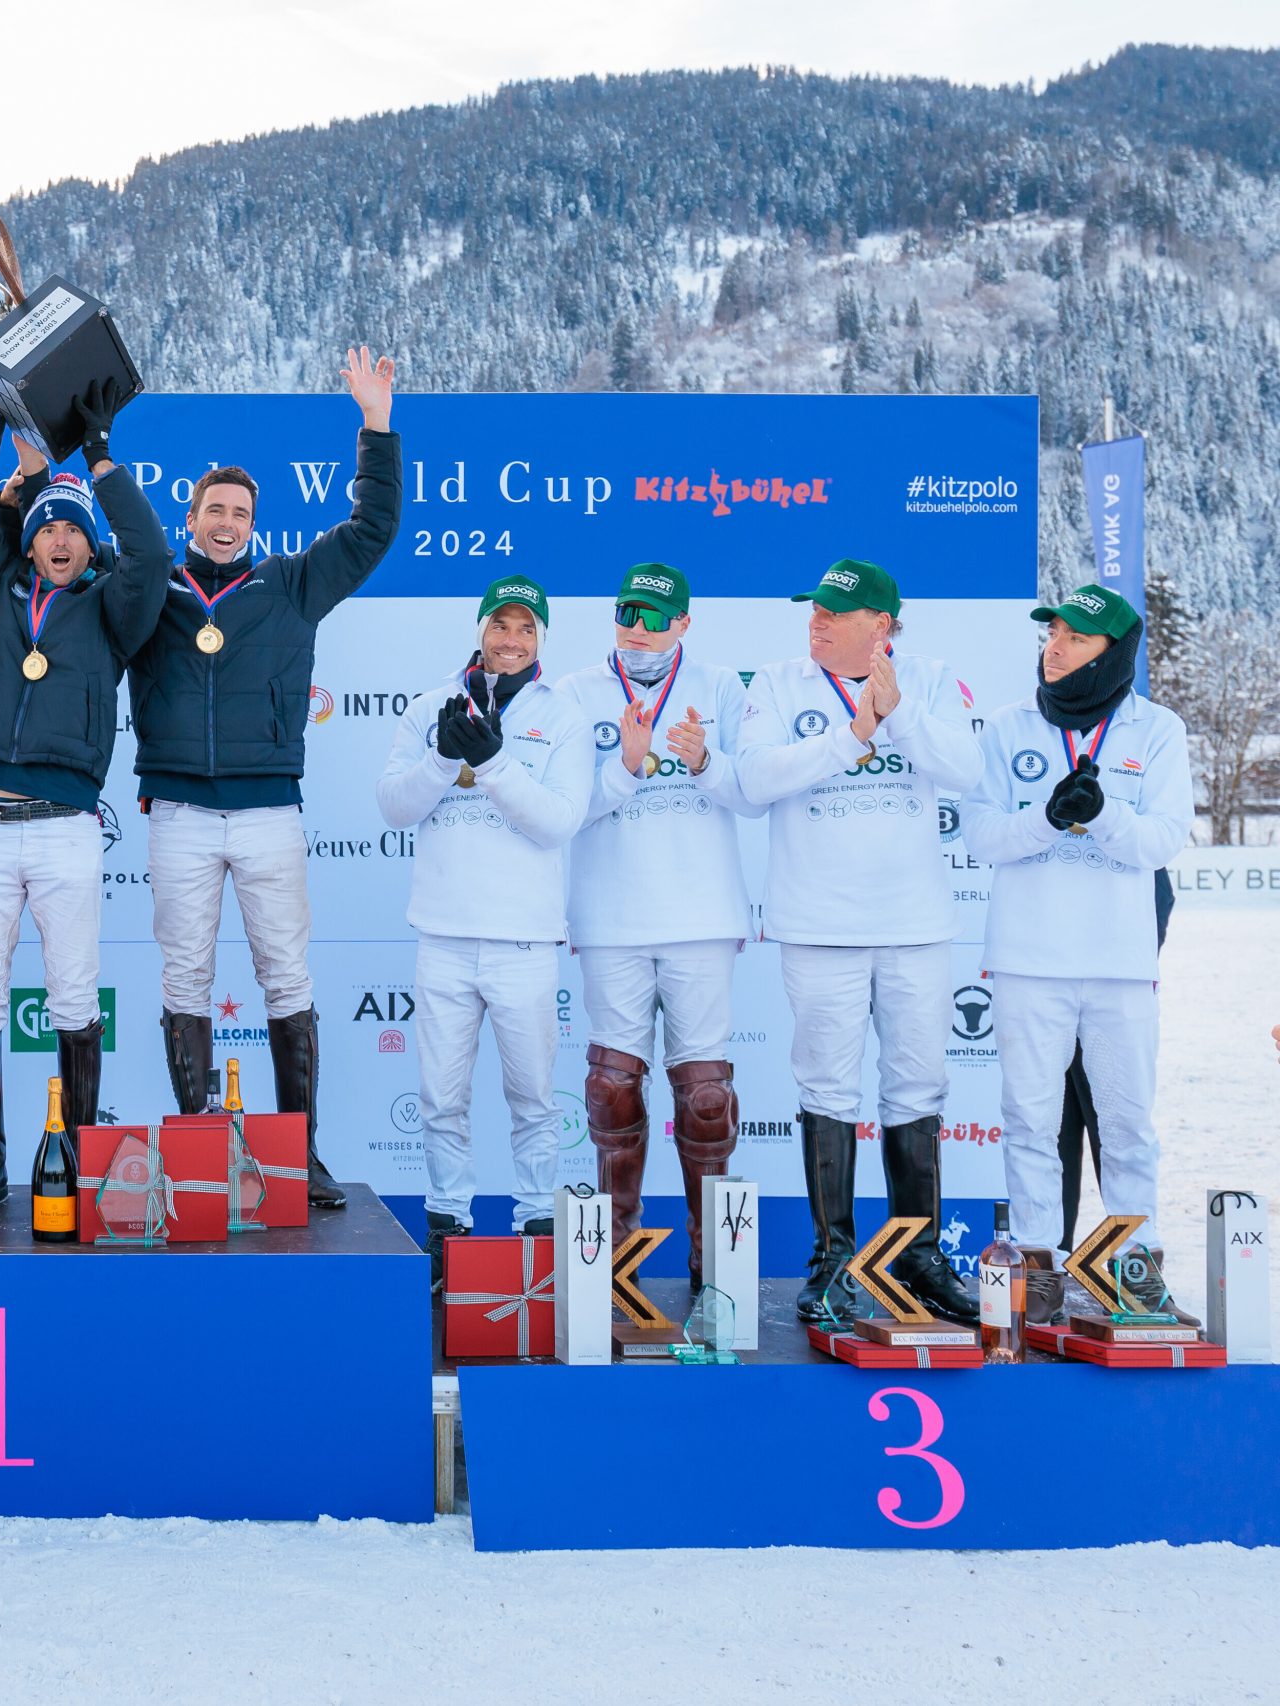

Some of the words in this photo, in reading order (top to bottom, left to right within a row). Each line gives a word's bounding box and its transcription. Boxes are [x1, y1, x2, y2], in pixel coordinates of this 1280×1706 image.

[0, 339, 21, 360] Snow
[19, 327, 36, 343] Polo
[36, 309, 56, 329] World
[55, 297, 71, 312] Cup
[3, 317, 34, 345] Bendura
[33, 301, 53, 319] Bank
[40, 319, 58, 336] 2003
[290, 461, 468, 503] Wold
[499, 461, 613, 515] Cup
[906, 476, 1018, 503] #kitzpolo
[906, 502, 1018, 516] kitzbuehelpolo.com
[414, 530, 515, 557] 2024
[344, 692, 424, 717] INTO
[1108, 766, 1145, 778] casablan
[811, 786, 839, 795] GREEN
[840, 783, 876, 792] ENERGY
[877, 782, 913, 791] PARTNER
[728, 1031, 767, 1043] ZANO
[738, 1121, 793, 1137] FABRIK
[368, 1141, 412, 1151] WEISSES
[721, 1216, 753, 1229] AIX
[573, 1229, 607, 1243] AIX
[1230, 1231, 1264, 1245] AIX
[924, 1334, 943, 1342] World
[944, 1334, 958, 1344] Cup
[868, 1387, 967, 1529] 3
